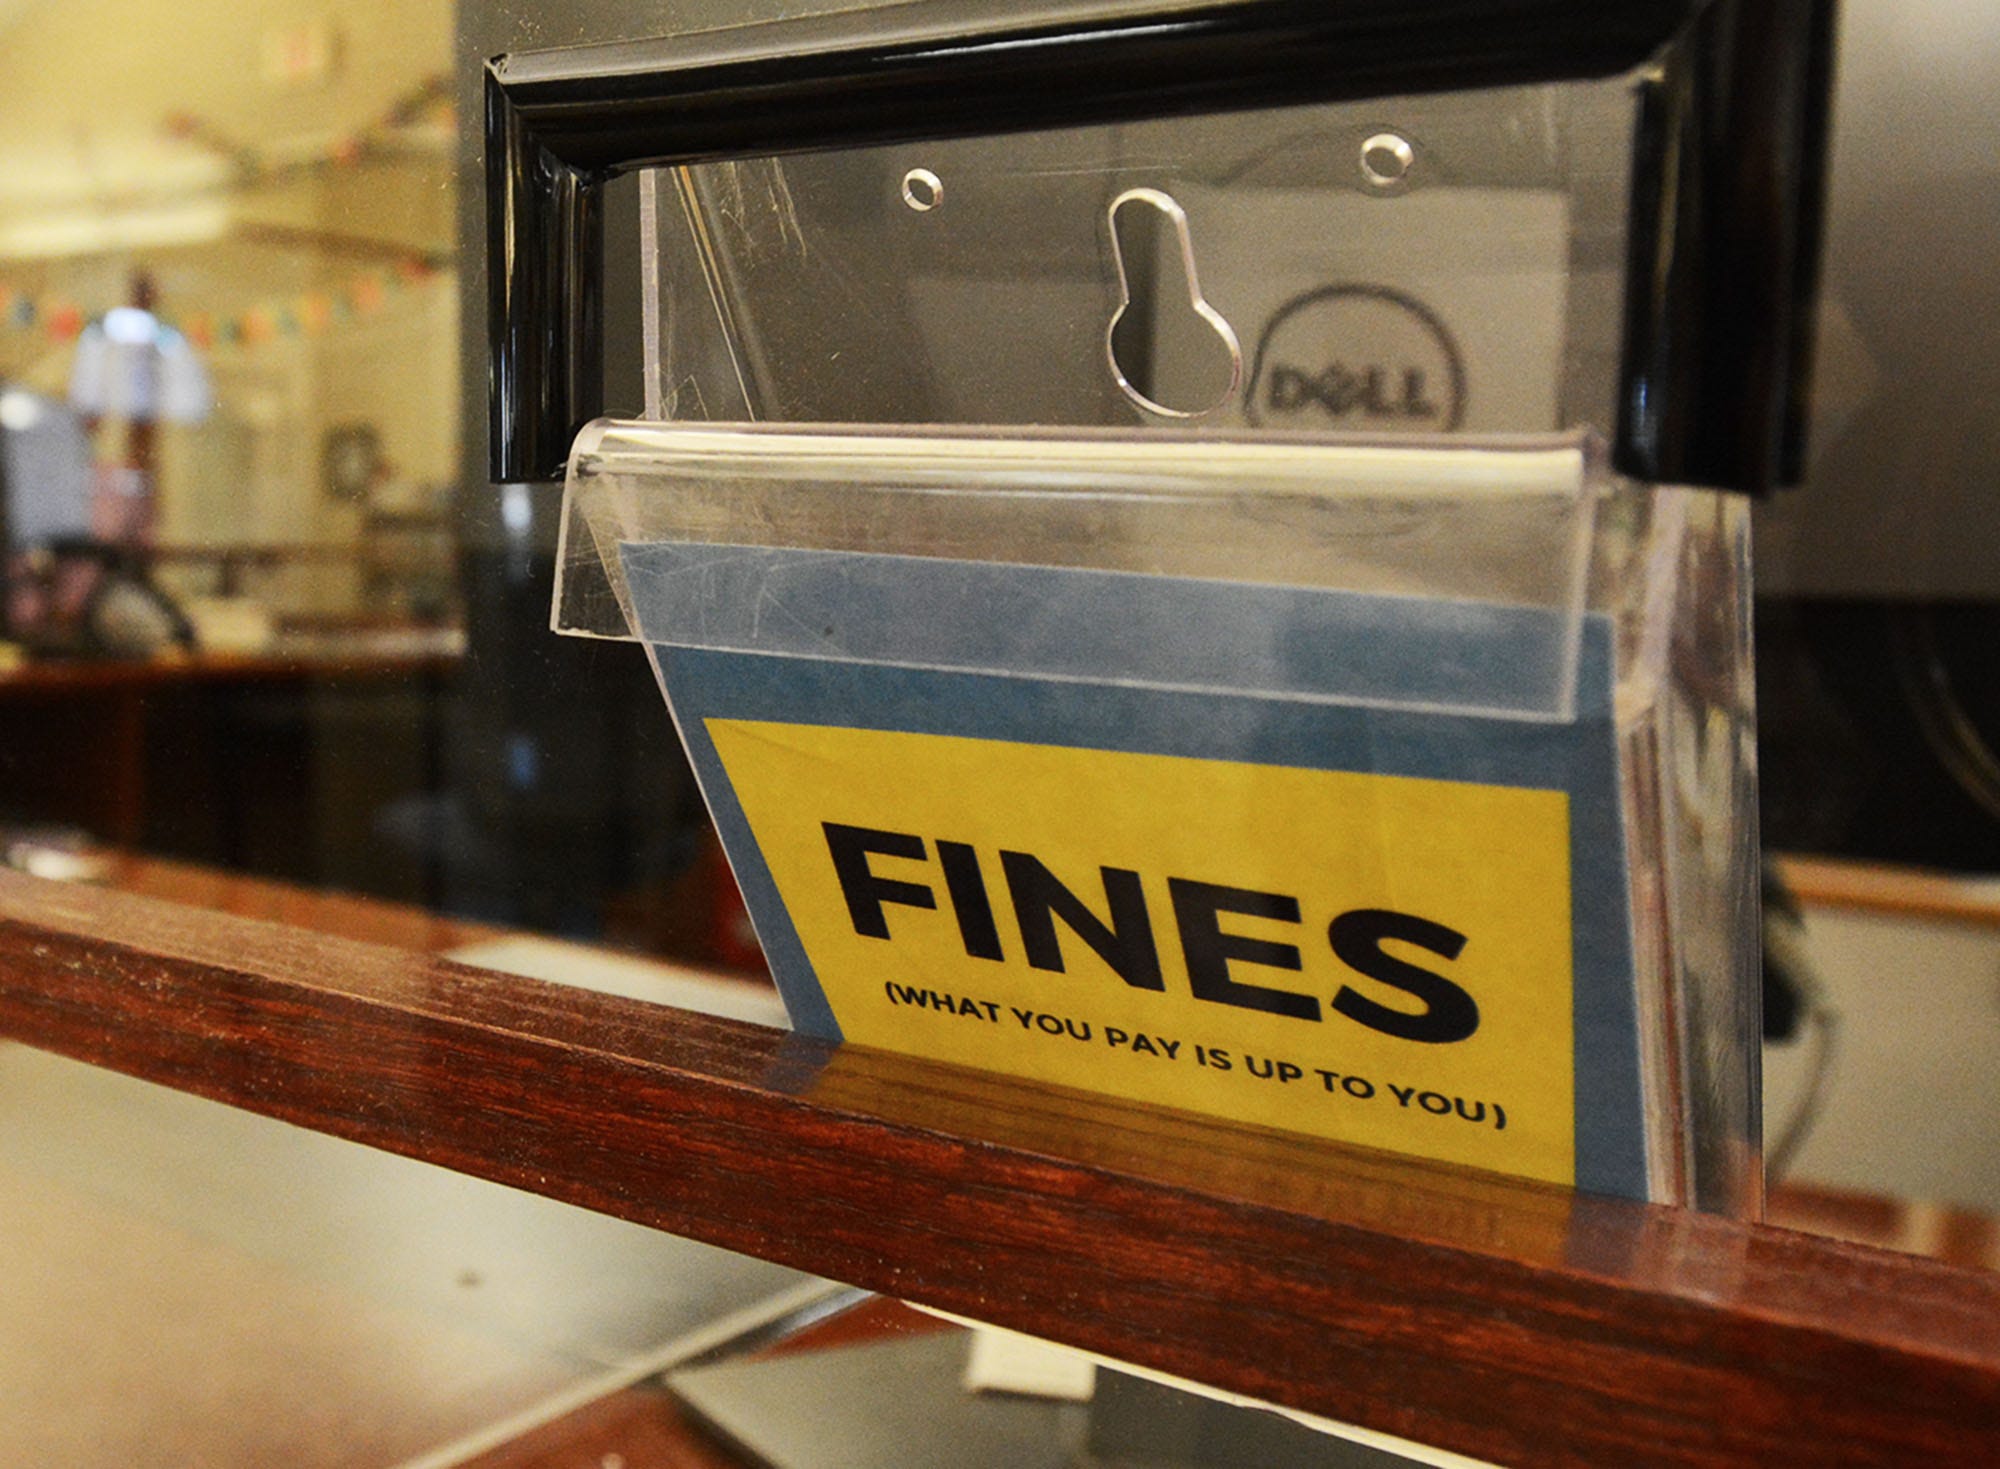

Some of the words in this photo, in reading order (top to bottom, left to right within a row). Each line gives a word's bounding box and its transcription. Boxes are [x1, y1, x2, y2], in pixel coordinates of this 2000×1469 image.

[1267, 363, 1436, 417] DELL
[821, 821, 1480, 1044] FINES
[884, 980, 1001, 1024] (WHAT
[1011, 1007, 1092, 1042] YOU
[1105, 1027, 1181, 1060] PAY
[1195, 1044, 1232, 1070] IS
[1245, 1056, 1303, 1085] UP
[1314, 1068, 1375, 1100] TO
[1387, 1082, 1507, 1130] YOU)
